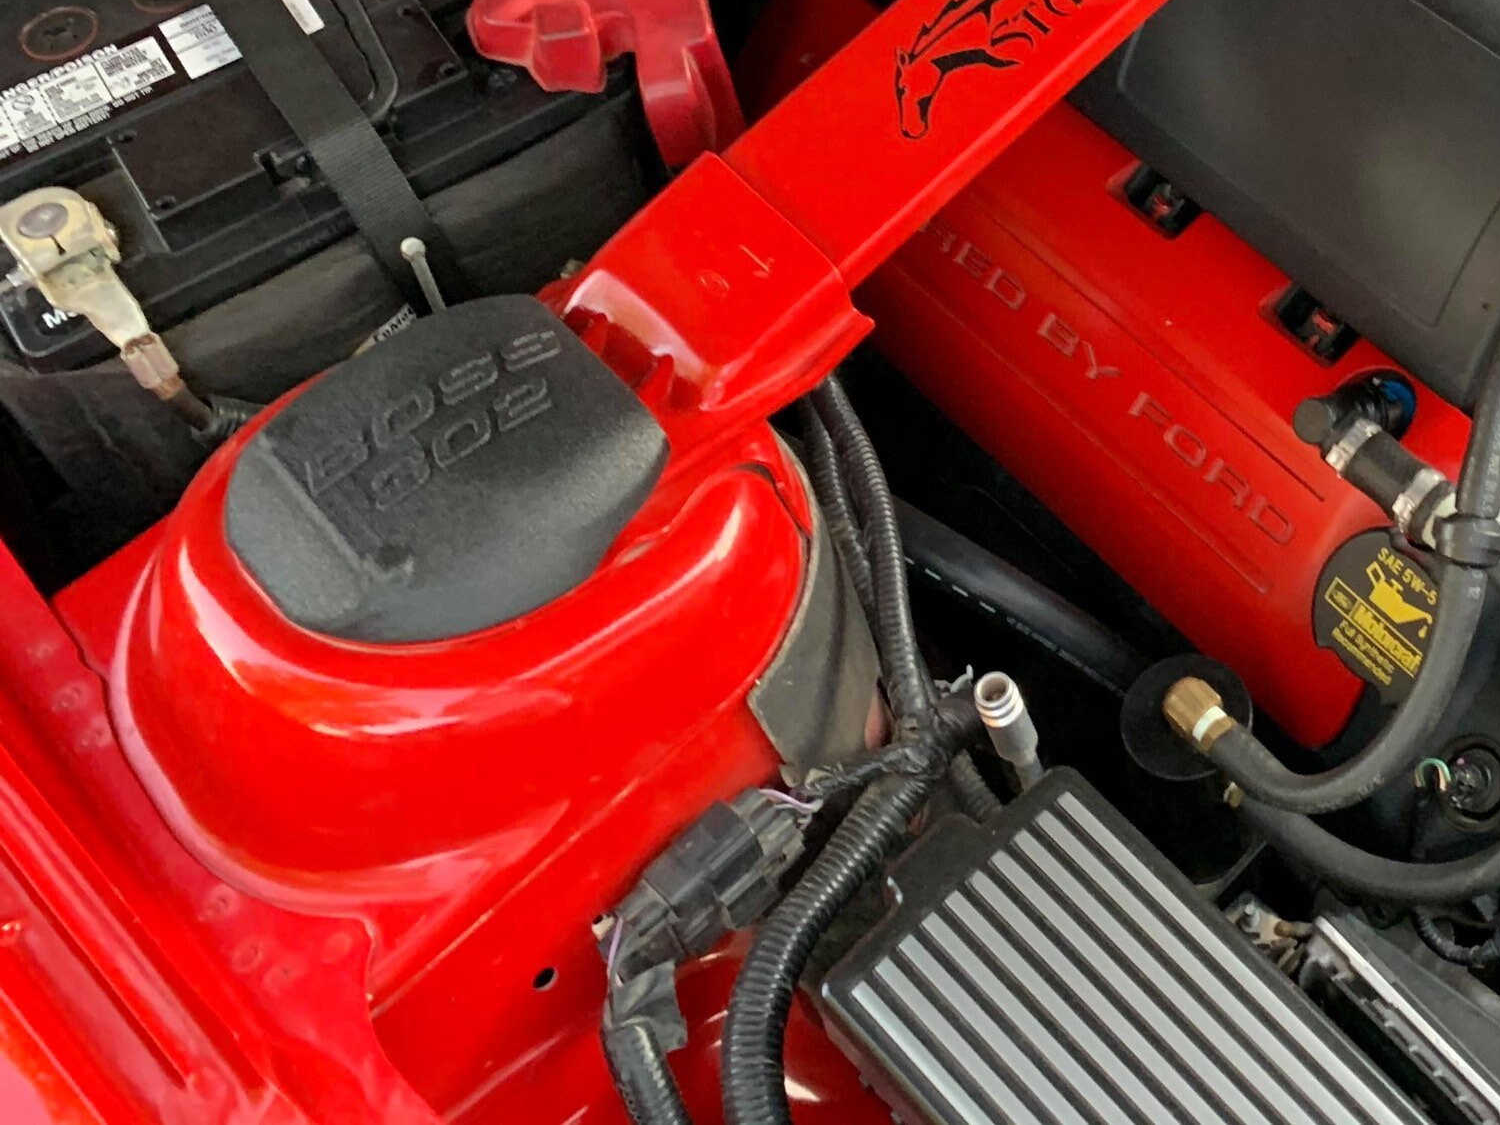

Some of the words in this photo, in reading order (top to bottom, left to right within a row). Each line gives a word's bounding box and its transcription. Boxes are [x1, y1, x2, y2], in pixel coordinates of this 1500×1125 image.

[0, 43, 119, 101] NGER/POISON
[304, 329, 562, 497] BOSS
[370, 376, 552, 512] 302
[1036, 312, 1124, 379] BY
[1128, 390, 1297, 546] FORD
[1377, 547, 1404, 575] SAE
[1402, 568, 1437, 606] 5W-5
[1339, 619, 1356, 638] Full
[1352, 604, 1422, 673] Motorcraf
